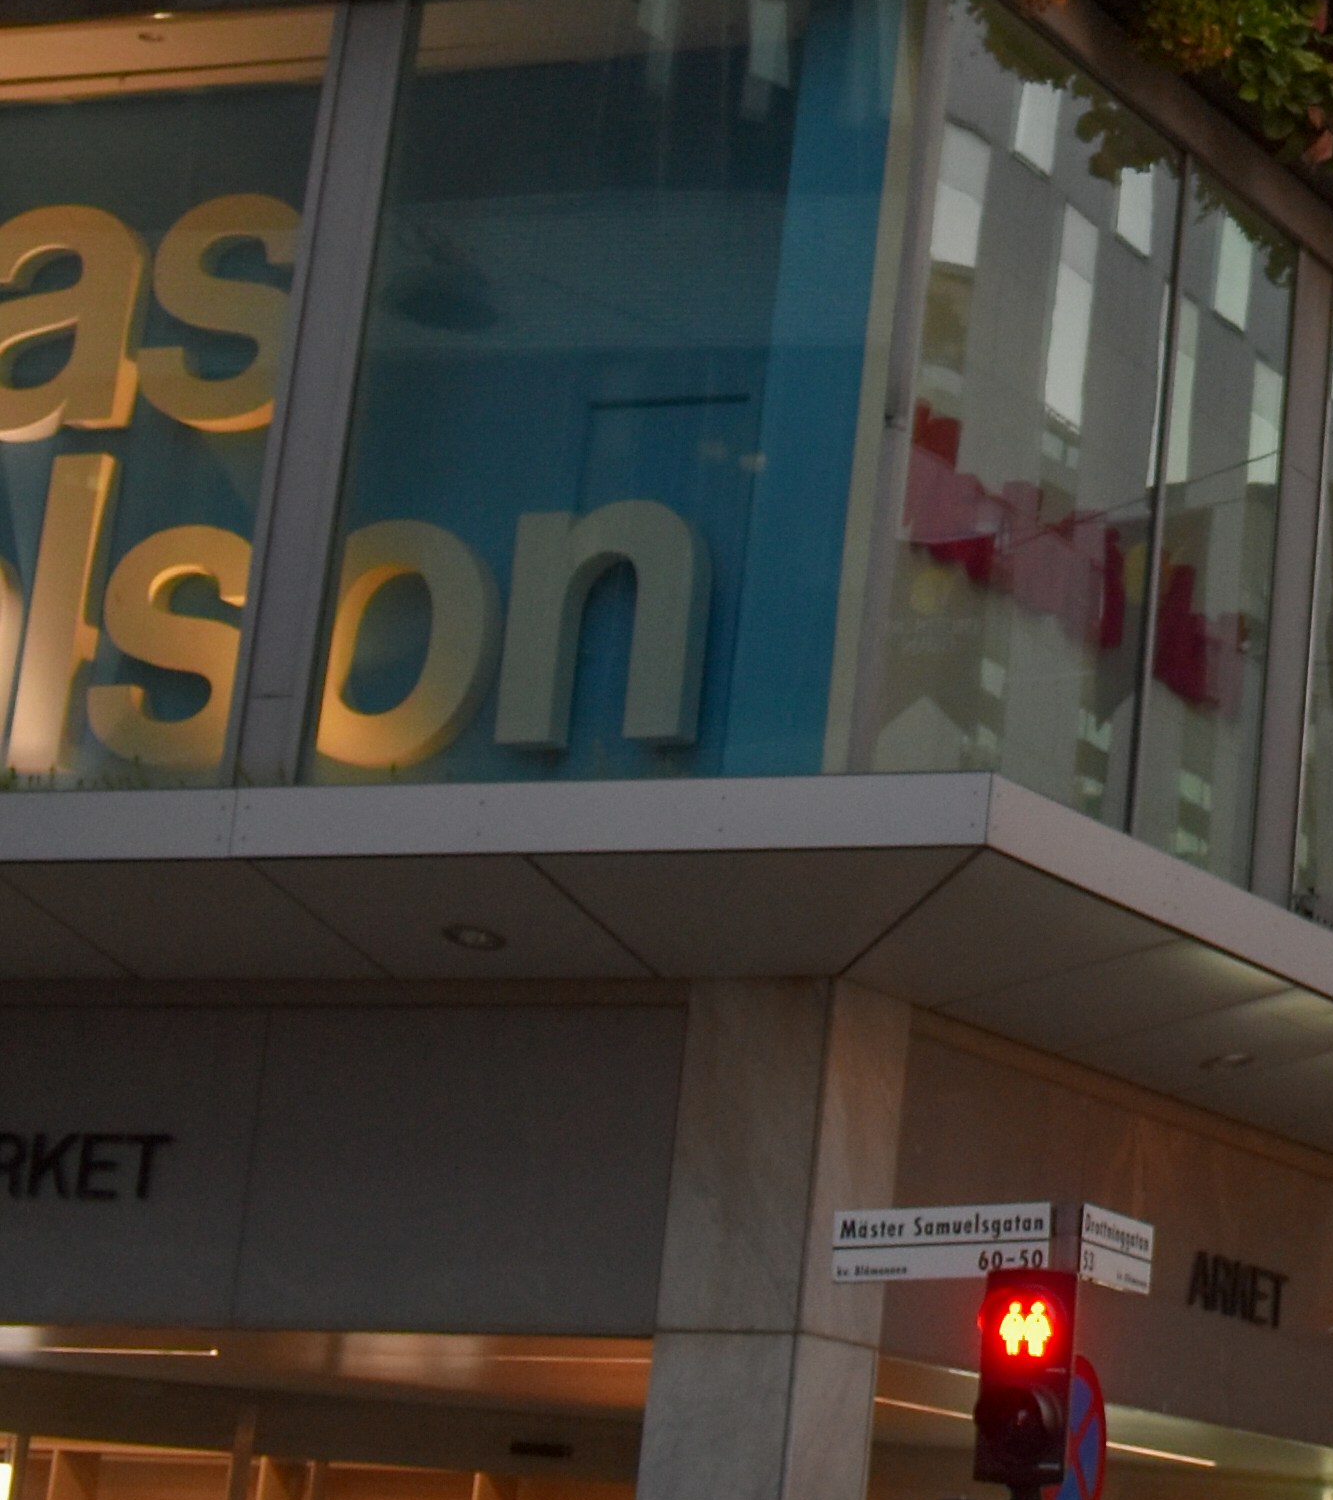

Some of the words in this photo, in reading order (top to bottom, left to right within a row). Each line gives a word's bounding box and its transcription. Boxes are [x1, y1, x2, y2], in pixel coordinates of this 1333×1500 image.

[840, 1216, 905, 1241] Mäster
[914, 1212, 1045, 1240] Samuelsgatan
[1084, 1212, 1149, 1252] Drottninggatan
[977, 1249, 1044, 1271] 60-50
[1082, 1249, 1095, 1271] 53
